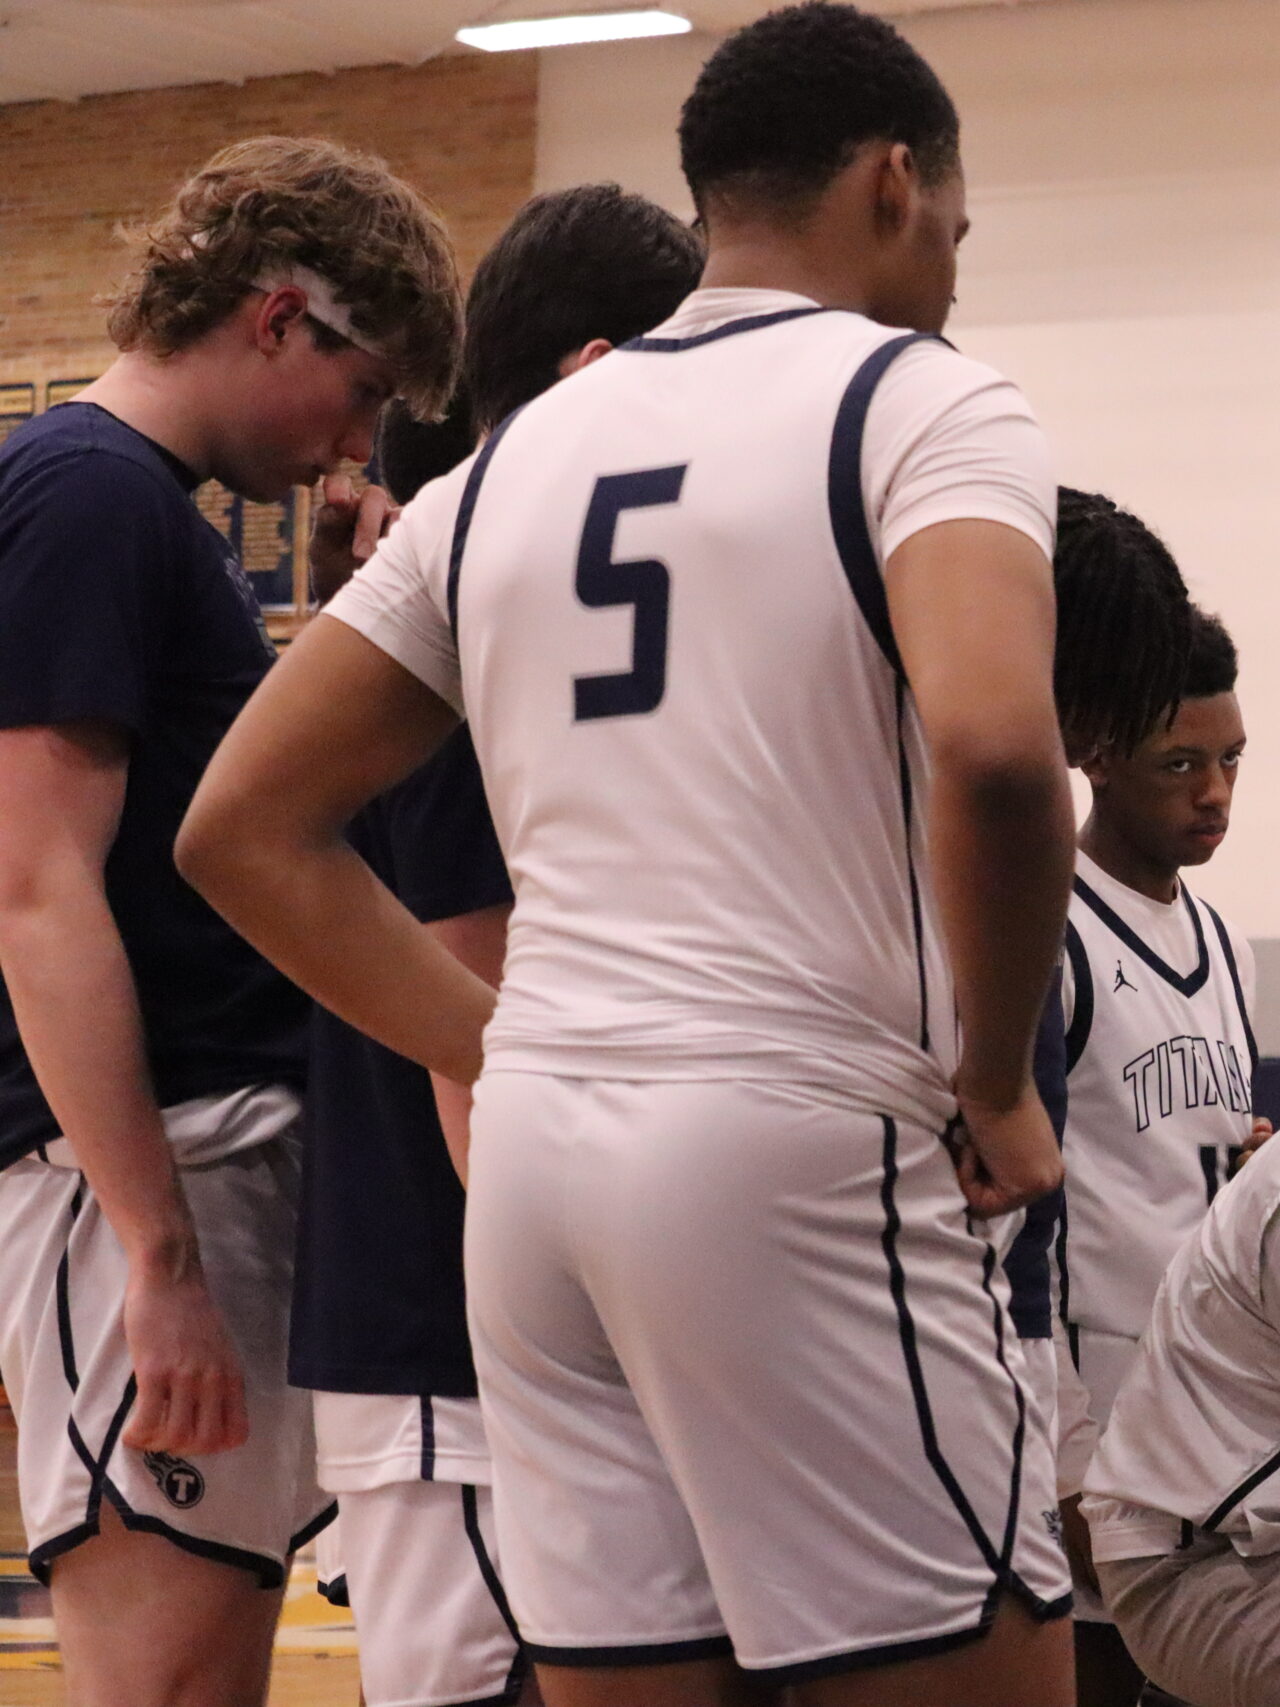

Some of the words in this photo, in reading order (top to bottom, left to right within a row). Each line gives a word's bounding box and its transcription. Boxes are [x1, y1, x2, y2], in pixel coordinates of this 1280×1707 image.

[572, 461, 690, 722] 5
[1123, 1034, 1251, 1133] TITAN
[172, 1472, 195, 1501] T
